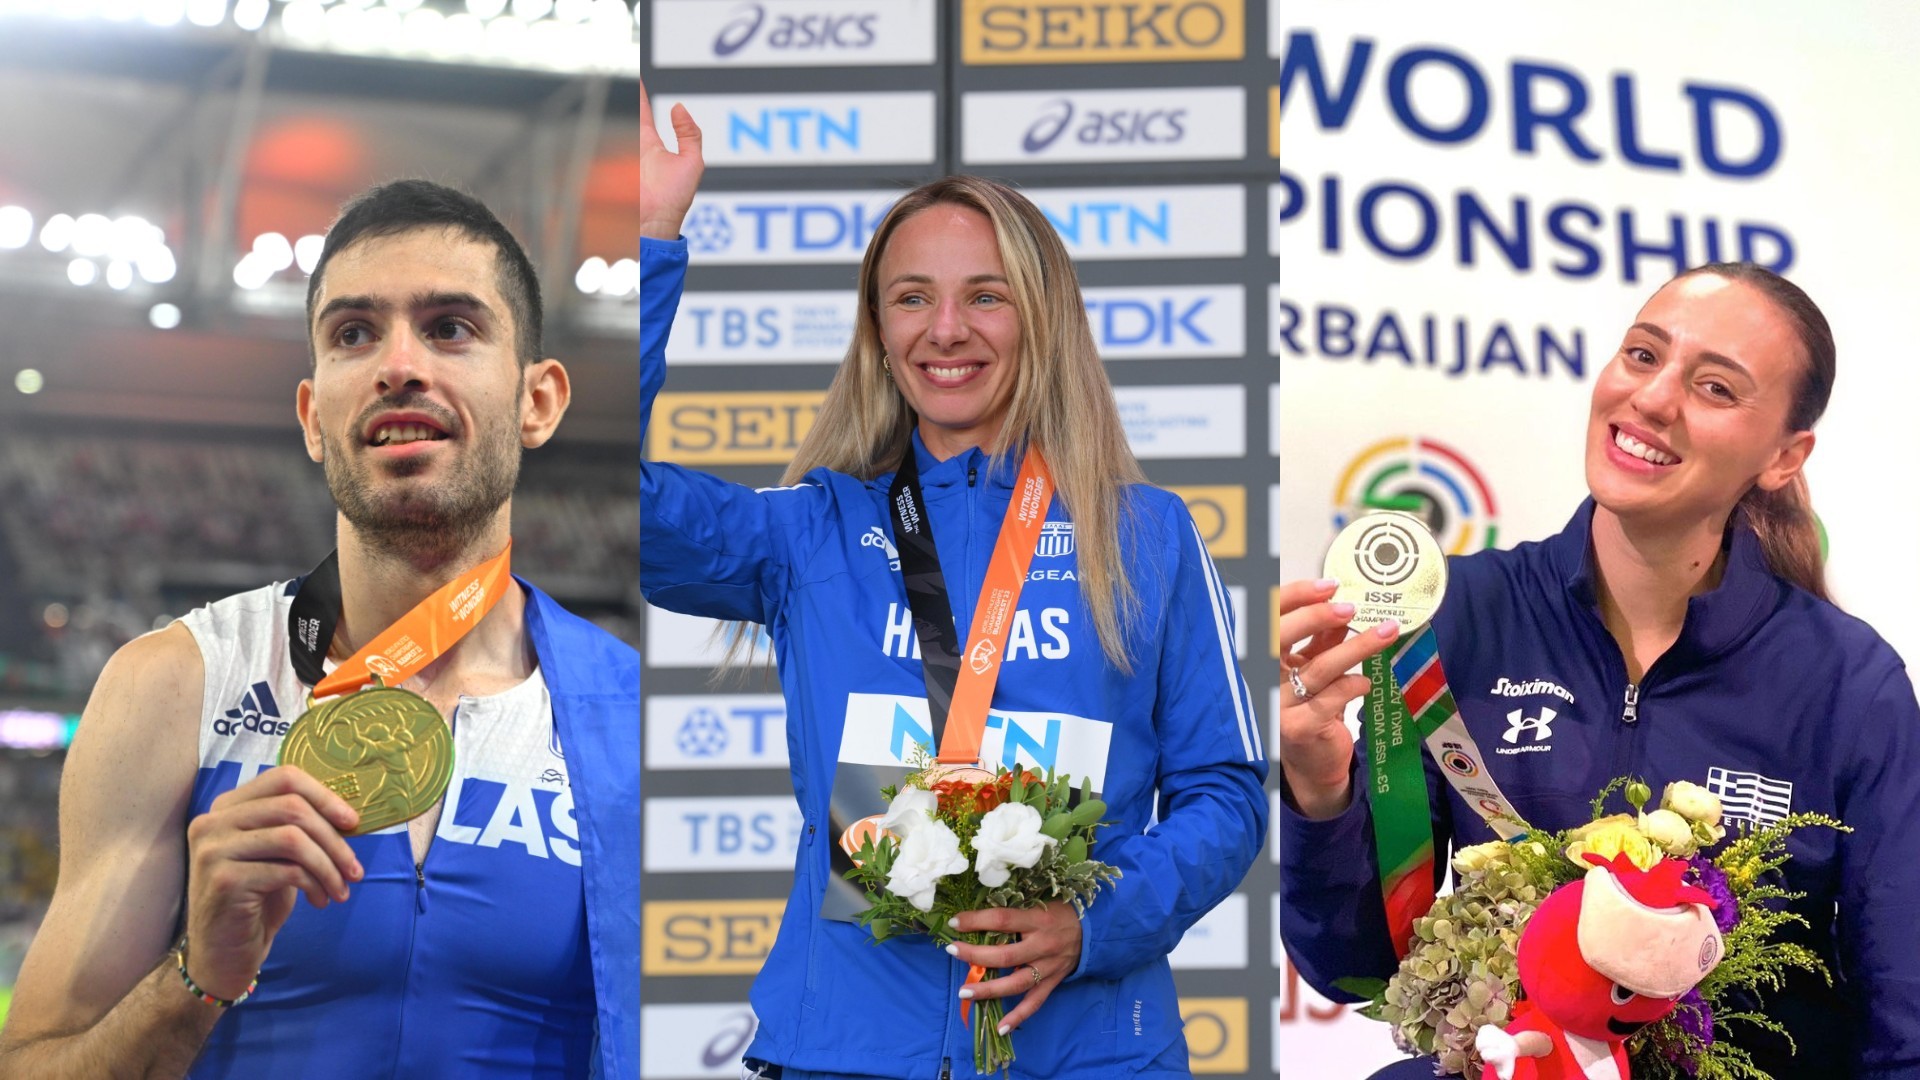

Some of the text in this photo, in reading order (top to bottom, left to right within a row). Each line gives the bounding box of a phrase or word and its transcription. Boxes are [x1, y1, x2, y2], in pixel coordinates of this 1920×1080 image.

[767, 14, 878, 49] asics
[981, 2, 1225, 51] SEIKO
[1280, 29, 1785, 180] WORLD
[728, 108, 861, 152] NTN
[1076, 109, 1188, 146] asics
[688, 307, 780, 349] TBS
[1085, 297, 1214, 346] DK
[669, 404, 816, 452] SEI
[896, 494, 913, 533] WITNESS
[902, 485, 920, 525] WONDER
[1018, 477, 1035, 522] WITNESS
[1029, 476, 1045, 519] WONDER
[1364, 591, 1403, 604] ISSF
[1372, 684, 1386, 737] WORLD
[1490, 677, 1575, 705] Stoiximan
[1376, 739, 1387, 765] ISSF
[1519, 745, 1552, 753] ARMOUR
[681, 812, 777, 857] TBS
